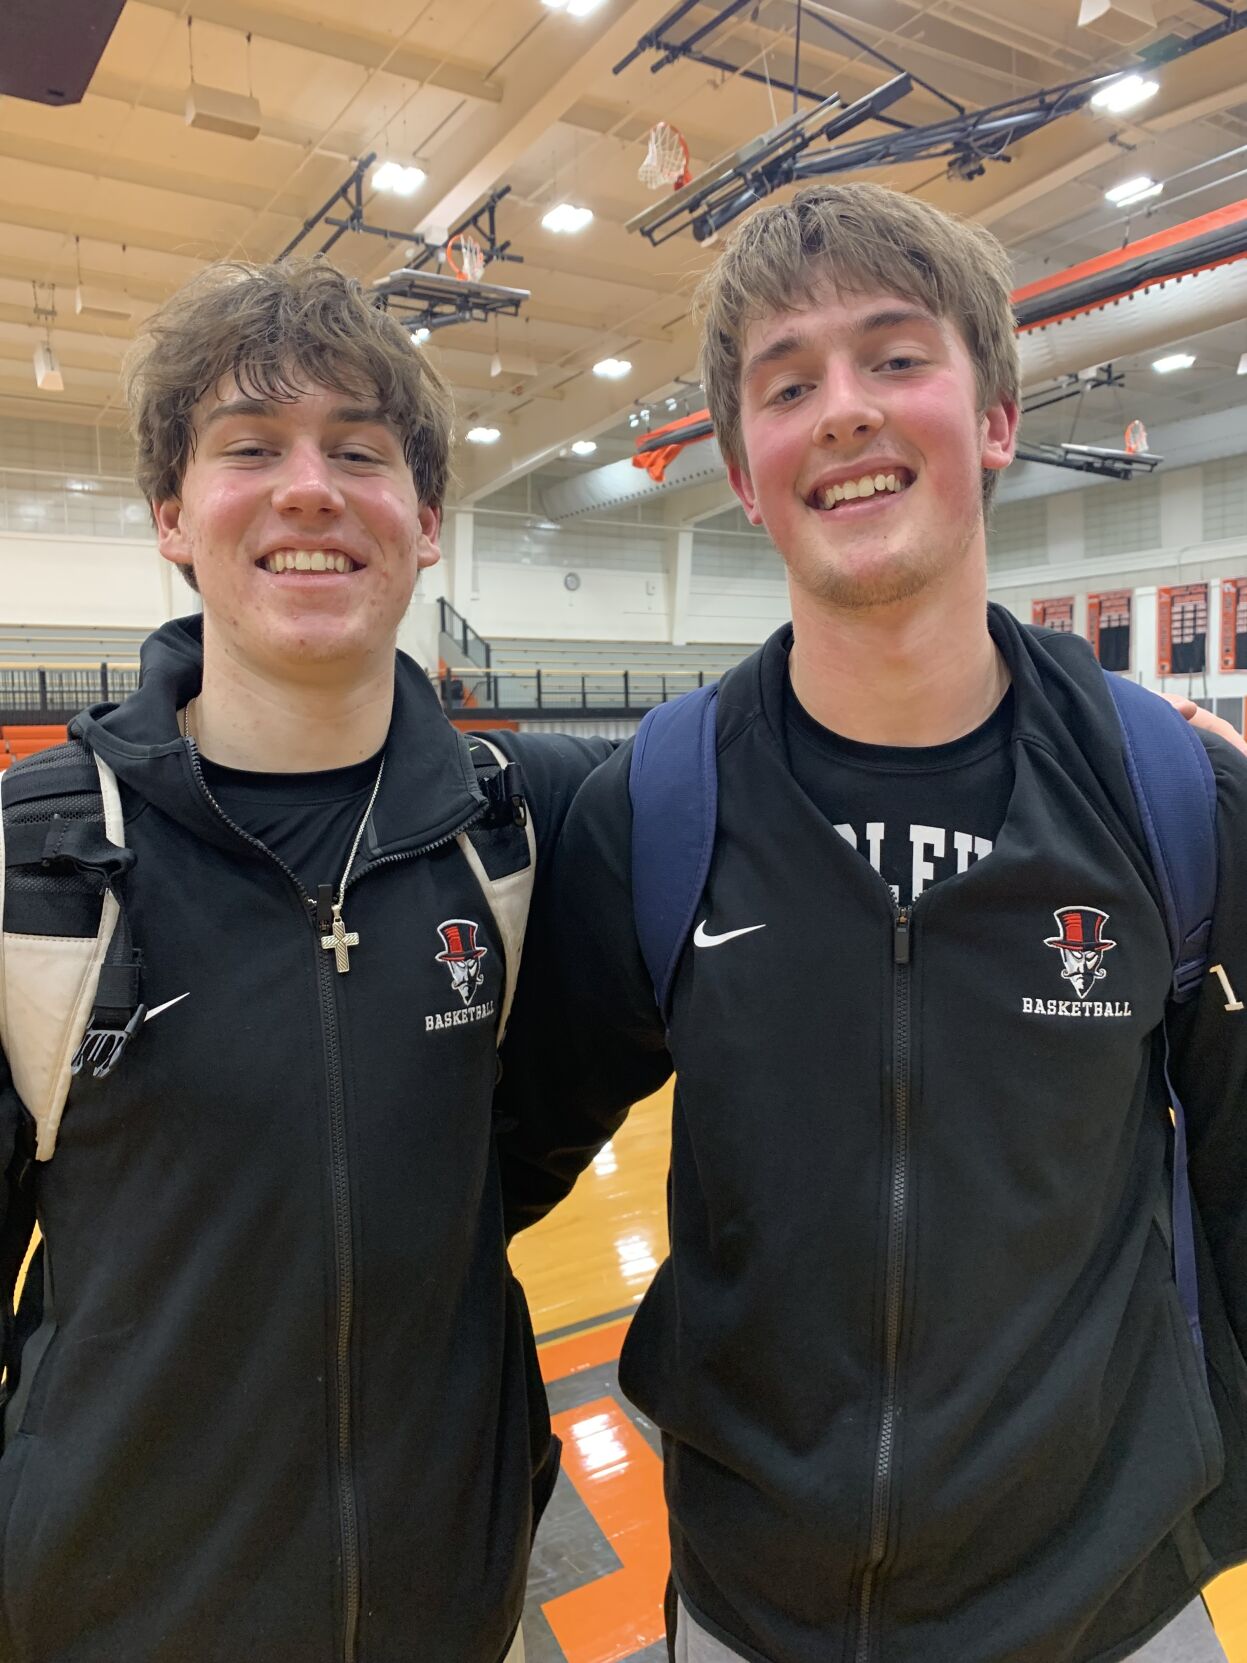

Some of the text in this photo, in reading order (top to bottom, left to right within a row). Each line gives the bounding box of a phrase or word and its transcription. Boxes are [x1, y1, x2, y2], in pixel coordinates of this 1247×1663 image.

[1209, 964, 1244, 1011] 1
[425, 1001, 494, 1031] BASKETBALL
[1022, 998, 1132, 1017] BASKETBALL
